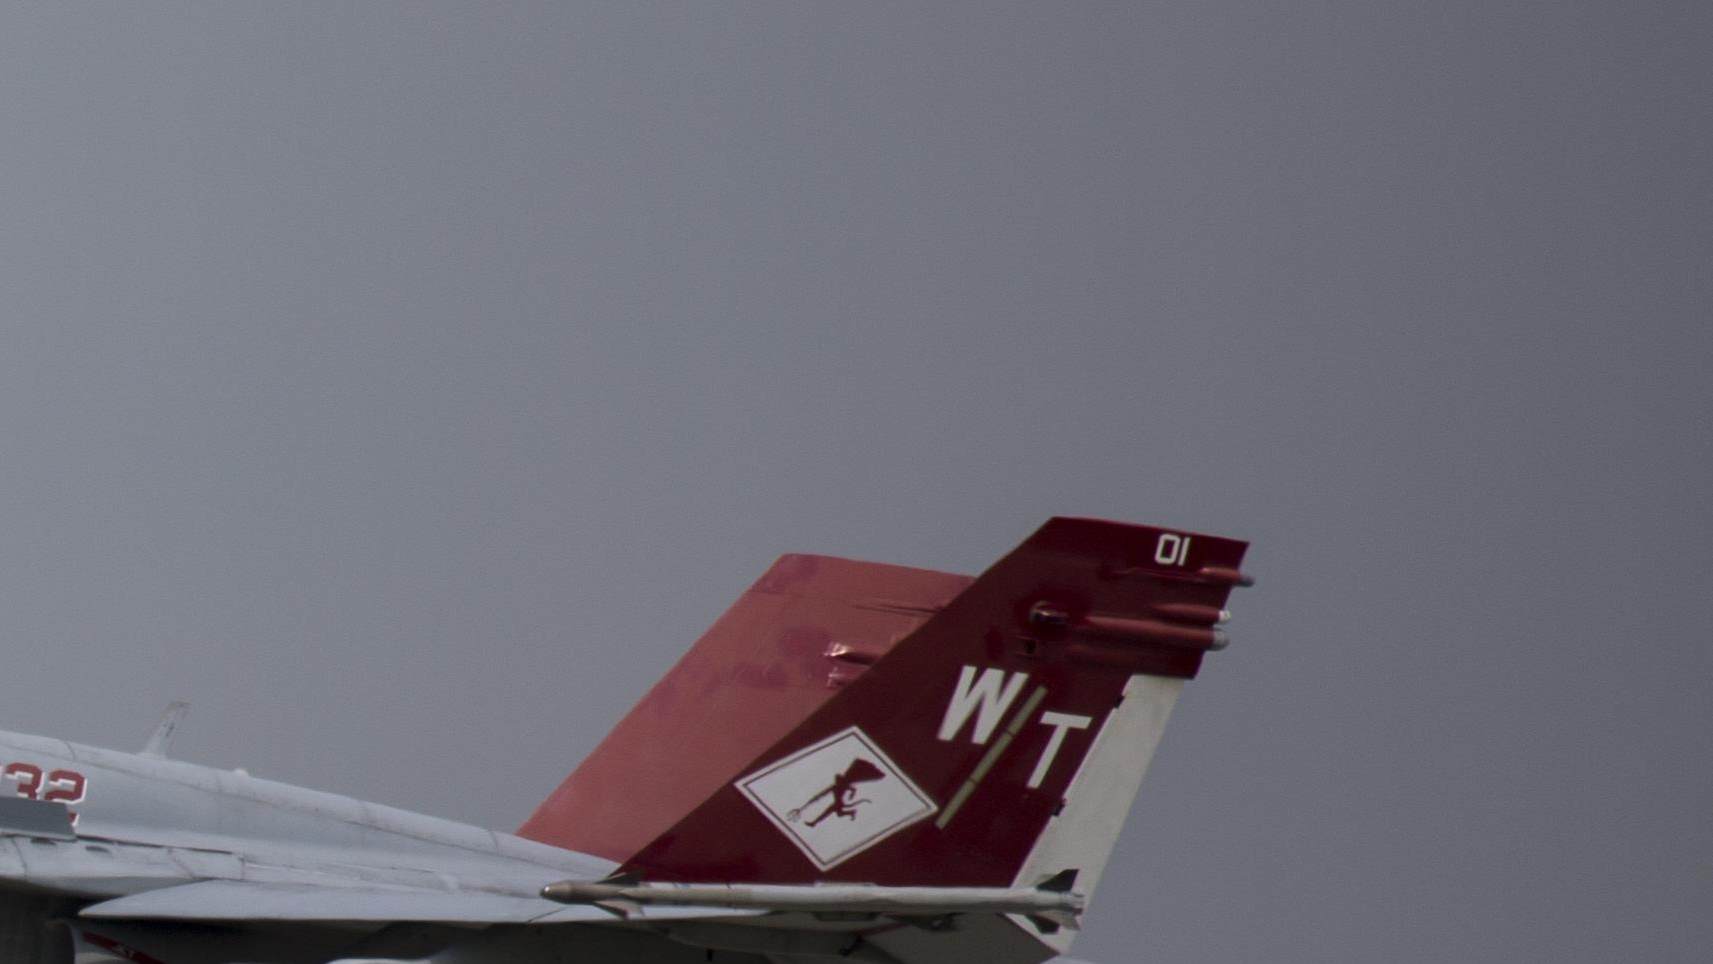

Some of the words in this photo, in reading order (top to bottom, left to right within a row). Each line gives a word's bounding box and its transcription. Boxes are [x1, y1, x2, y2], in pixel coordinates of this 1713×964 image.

[1154, 533, 1192, 567] 01
[936, 664, 1031, 746] W
[1025, 710, 1093, 790] T
